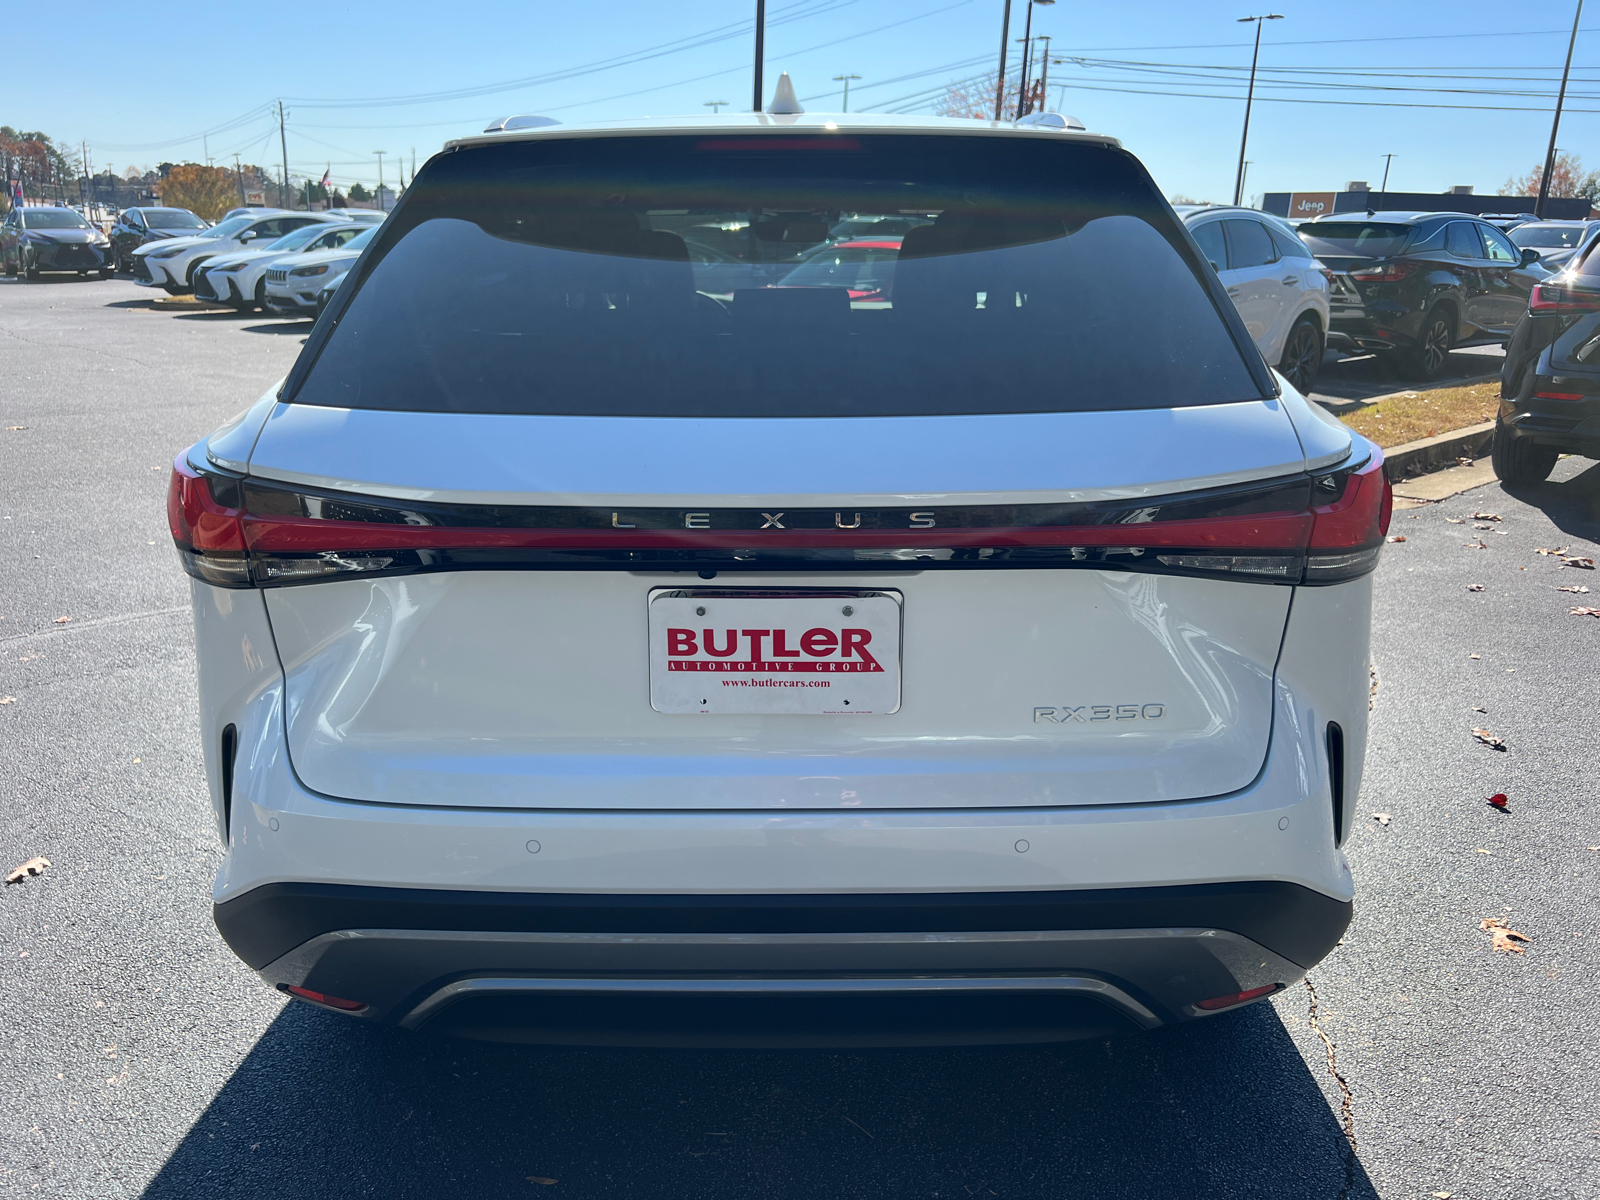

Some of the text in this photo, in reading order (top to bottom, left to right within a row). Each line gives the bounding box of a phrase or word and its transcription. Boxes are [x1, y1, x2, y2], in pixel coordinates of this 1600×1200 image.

[1298, 199, 1324, 212] Jeep
[611, 511, 936, 529] LEXUS
[669, 661, 877, 672] AUTOMOTIVE GROUP
[721, 678, 831, 688] www.butlercars.com
